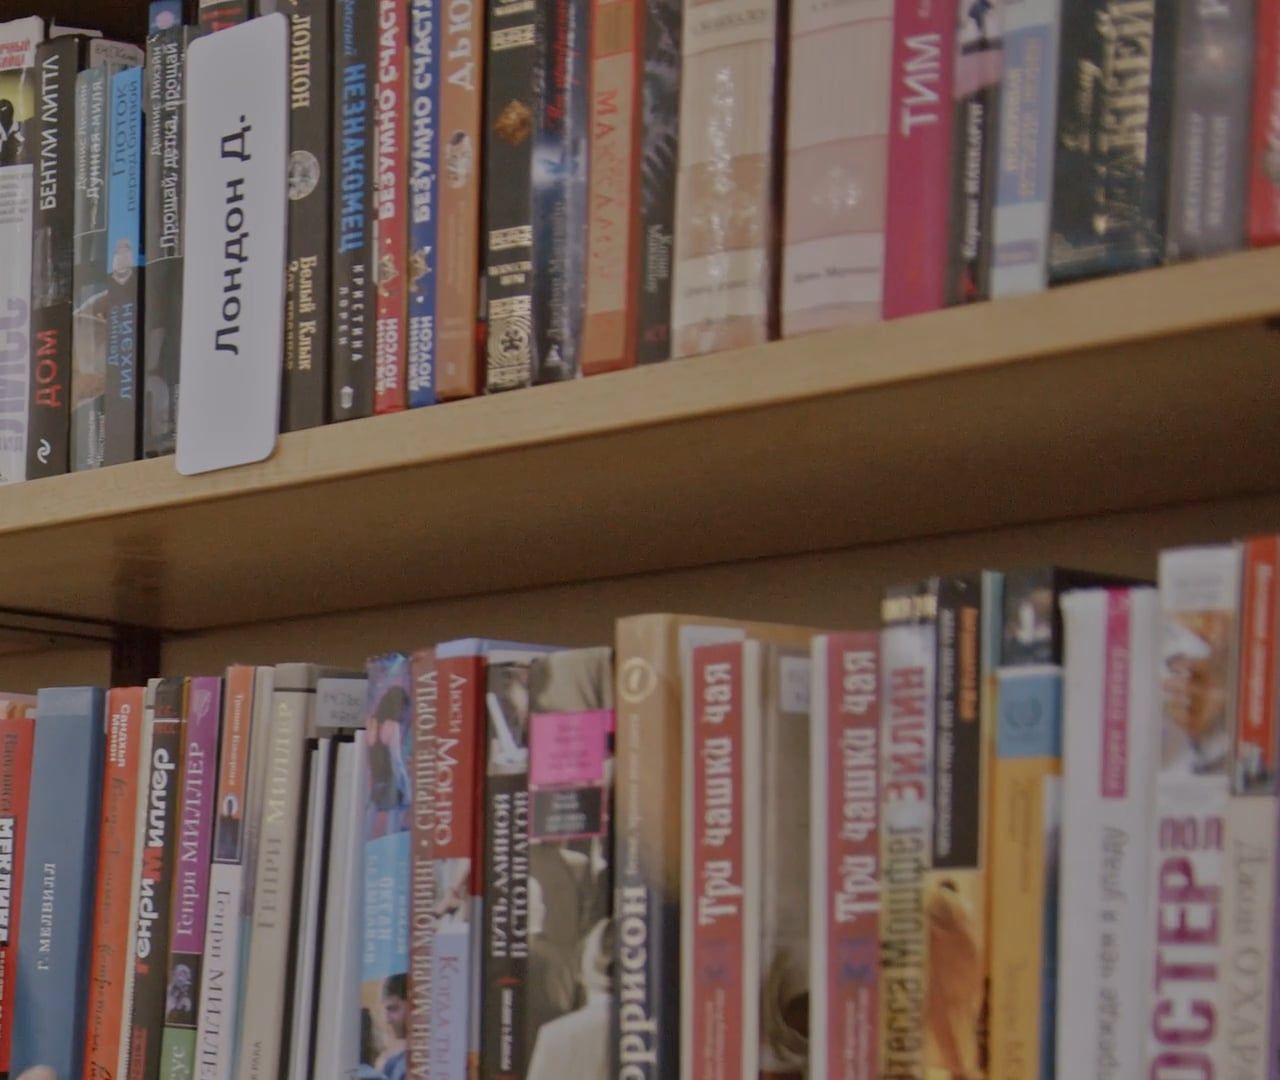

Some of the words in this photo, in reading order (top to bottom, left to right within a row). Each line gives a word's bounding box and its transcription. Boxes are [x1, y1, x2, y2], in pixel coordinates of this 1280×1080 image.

[39, 54, 60, 123] ЛИТТЛ
[291, 14, 312, 109] ЛОНДОН
[901, 34, 943, 137] ТИМ
[39, 127, 59, 211] БЕНТЛИ
[220, 114, 251, 162] Д.
[214, 178, 249, 356] Лондон
[298, 255, 317, 313] Белый
[36, 329, 63, 409] ДОМ
[108, 305, 120, 367] Деннис
[119, 303, 135, 401] ЛИХЭЙН
[298, 320, 316, 371] Клык
[385, 318, 399, 389] ЛОУСОН
[419, 315, 433, 388] ЛОУСОН
[418, 671, 440, 742] ГОРЦА
[701, 661, 734, 725] чая
[841, 650, 878, 716] чая
[108, 713, 120, 763] Менон
[117, 703, 130, 768] Сандхья
[266, 700, 295, 825] МИЛЛЕР
[178, 741, 206, 862] МИЛЛЕР
[415, 750, 439, 831] СЕРДЦЕ
[432, 737, 461, 847] МОНРО
[700, 735, 736, 847] чашки
[840, 727, 877, 843] чашки
[511, 790, 530, 881] ШАГОВ
[1160, 815, 1226, 852] ПОЛ
[38, 861, 57, 953] МЕЛВИЛЛ
[176, 866, 197, 937] Генри
[256, 837, 281, 929] ГЕНРИ
[412, 855, 436, 948] МОНИНГ
[510, 886, 530, 938] СТО
[697, 859, 742, 924] Три
[834, 855, 881, 924] Три
[212, 888, 230, 960] Генри
[510, 944, 529, 958] В
[36, 957, 51, 971] Г.
[410, 952, 434, 1016] МАРИ
[437, 955, 461, 1029] КОГДА
[250, 1040, 262, 1073] РАКА
[434, 1032, 452, 1067] ТЫ
